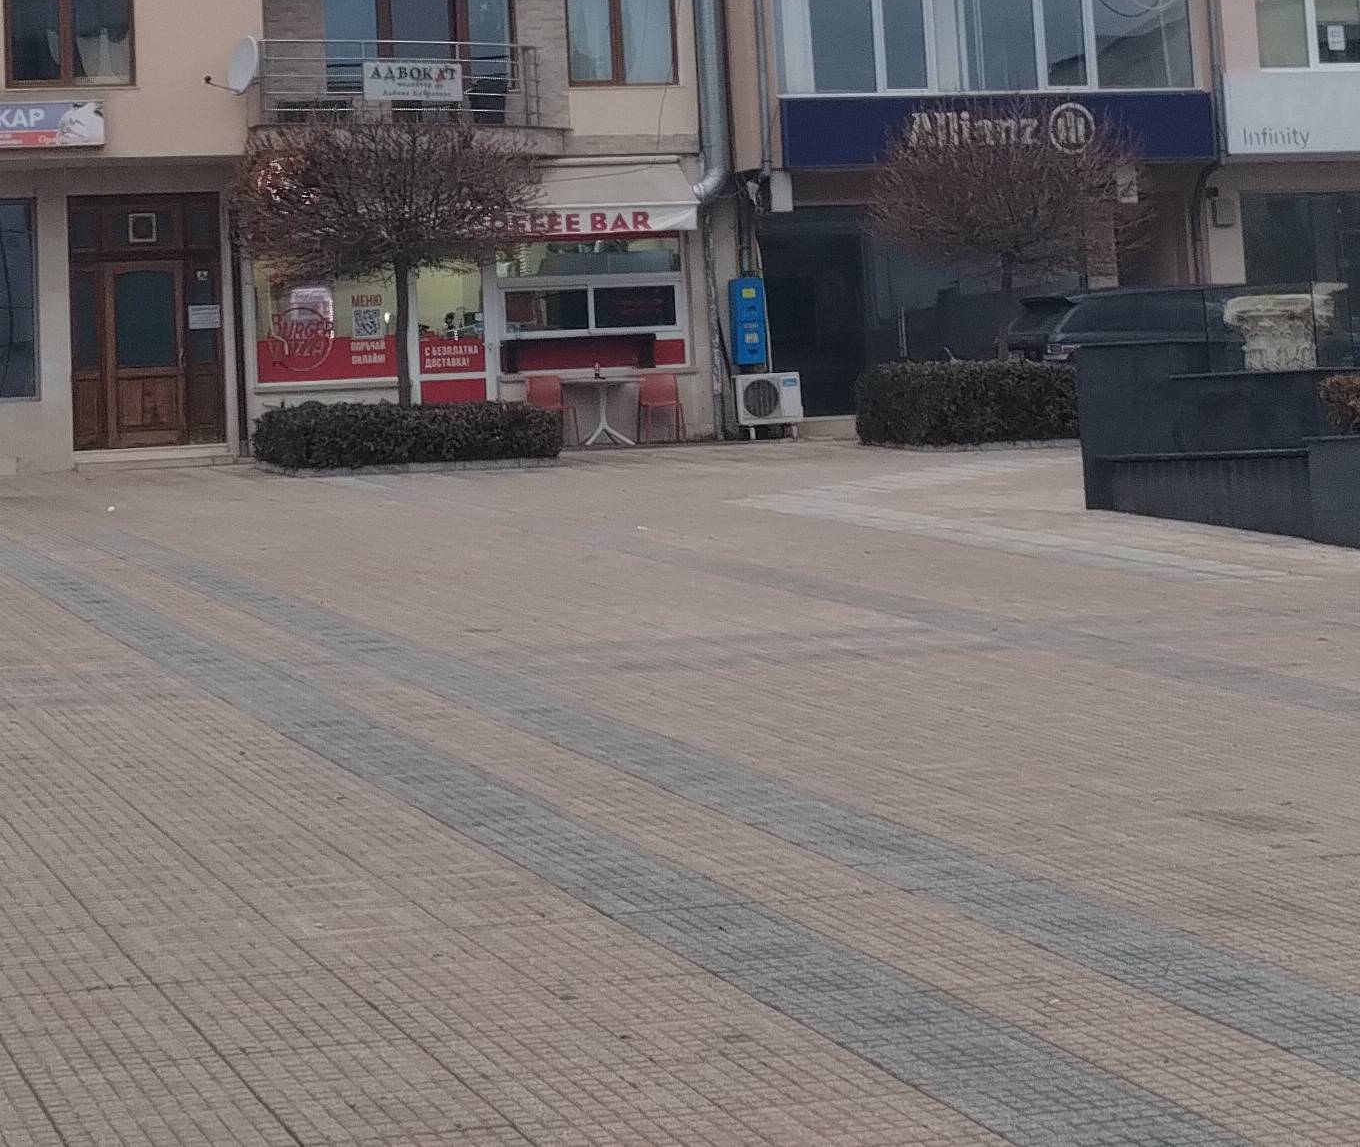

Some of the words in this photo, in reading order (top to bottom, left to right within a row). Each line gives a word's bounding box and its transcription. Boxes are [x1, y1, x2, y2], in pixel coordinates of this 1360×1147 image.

[369, 65, 457, 81] АДВОКАТ
[909, 111, 1039, 148] Allianz
[1243, 126, 1310, 148] Infinity
[590, 211, 653, 232] BAR
[351, 293, 382, 307] МЕНЮ
